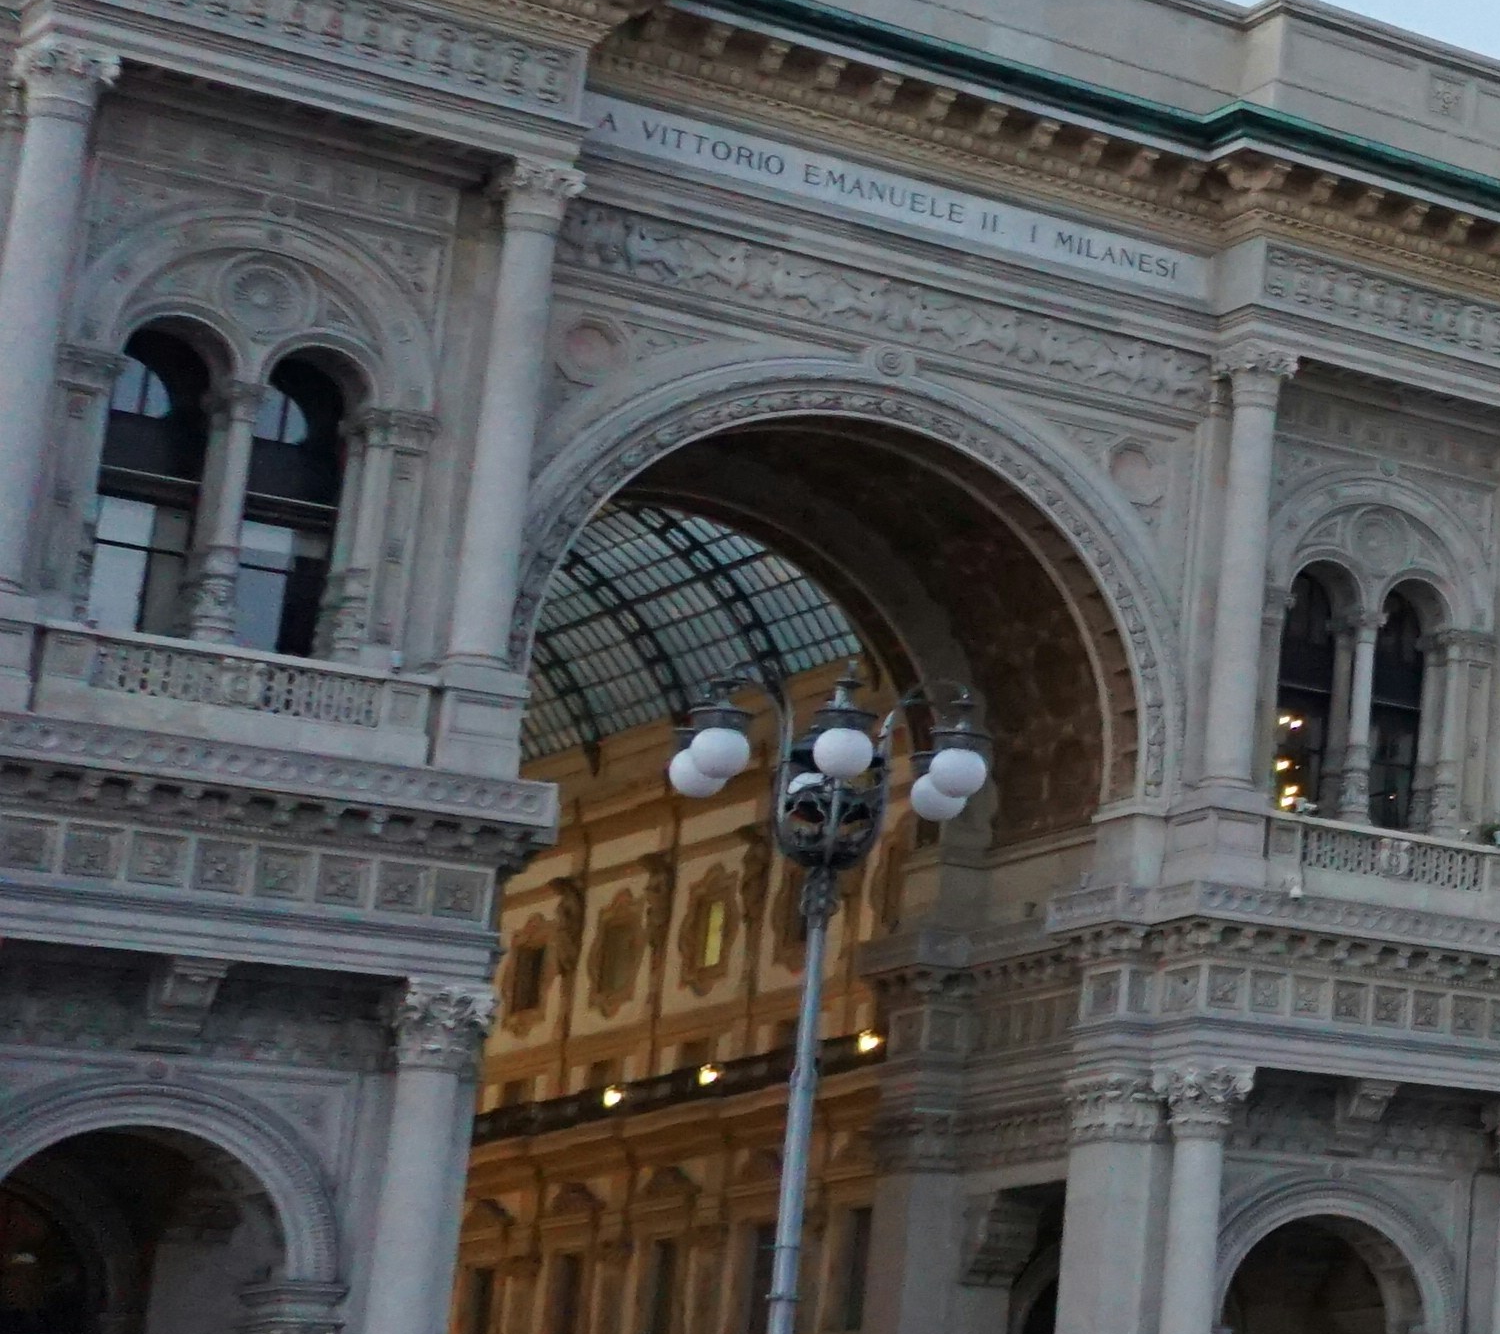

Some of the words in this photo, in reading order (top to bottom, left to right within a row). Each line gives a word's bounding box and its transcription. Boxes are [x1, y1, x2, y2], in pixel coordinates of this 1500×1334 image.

[599, 113, 618, 132] A
[642, 122, 785, 175] VITTORIO
[803, 163, 964, 225] EMANUELE
[1029, 224, 1038, 243] I
[1056, 231, 1180, 279] MILANESI
